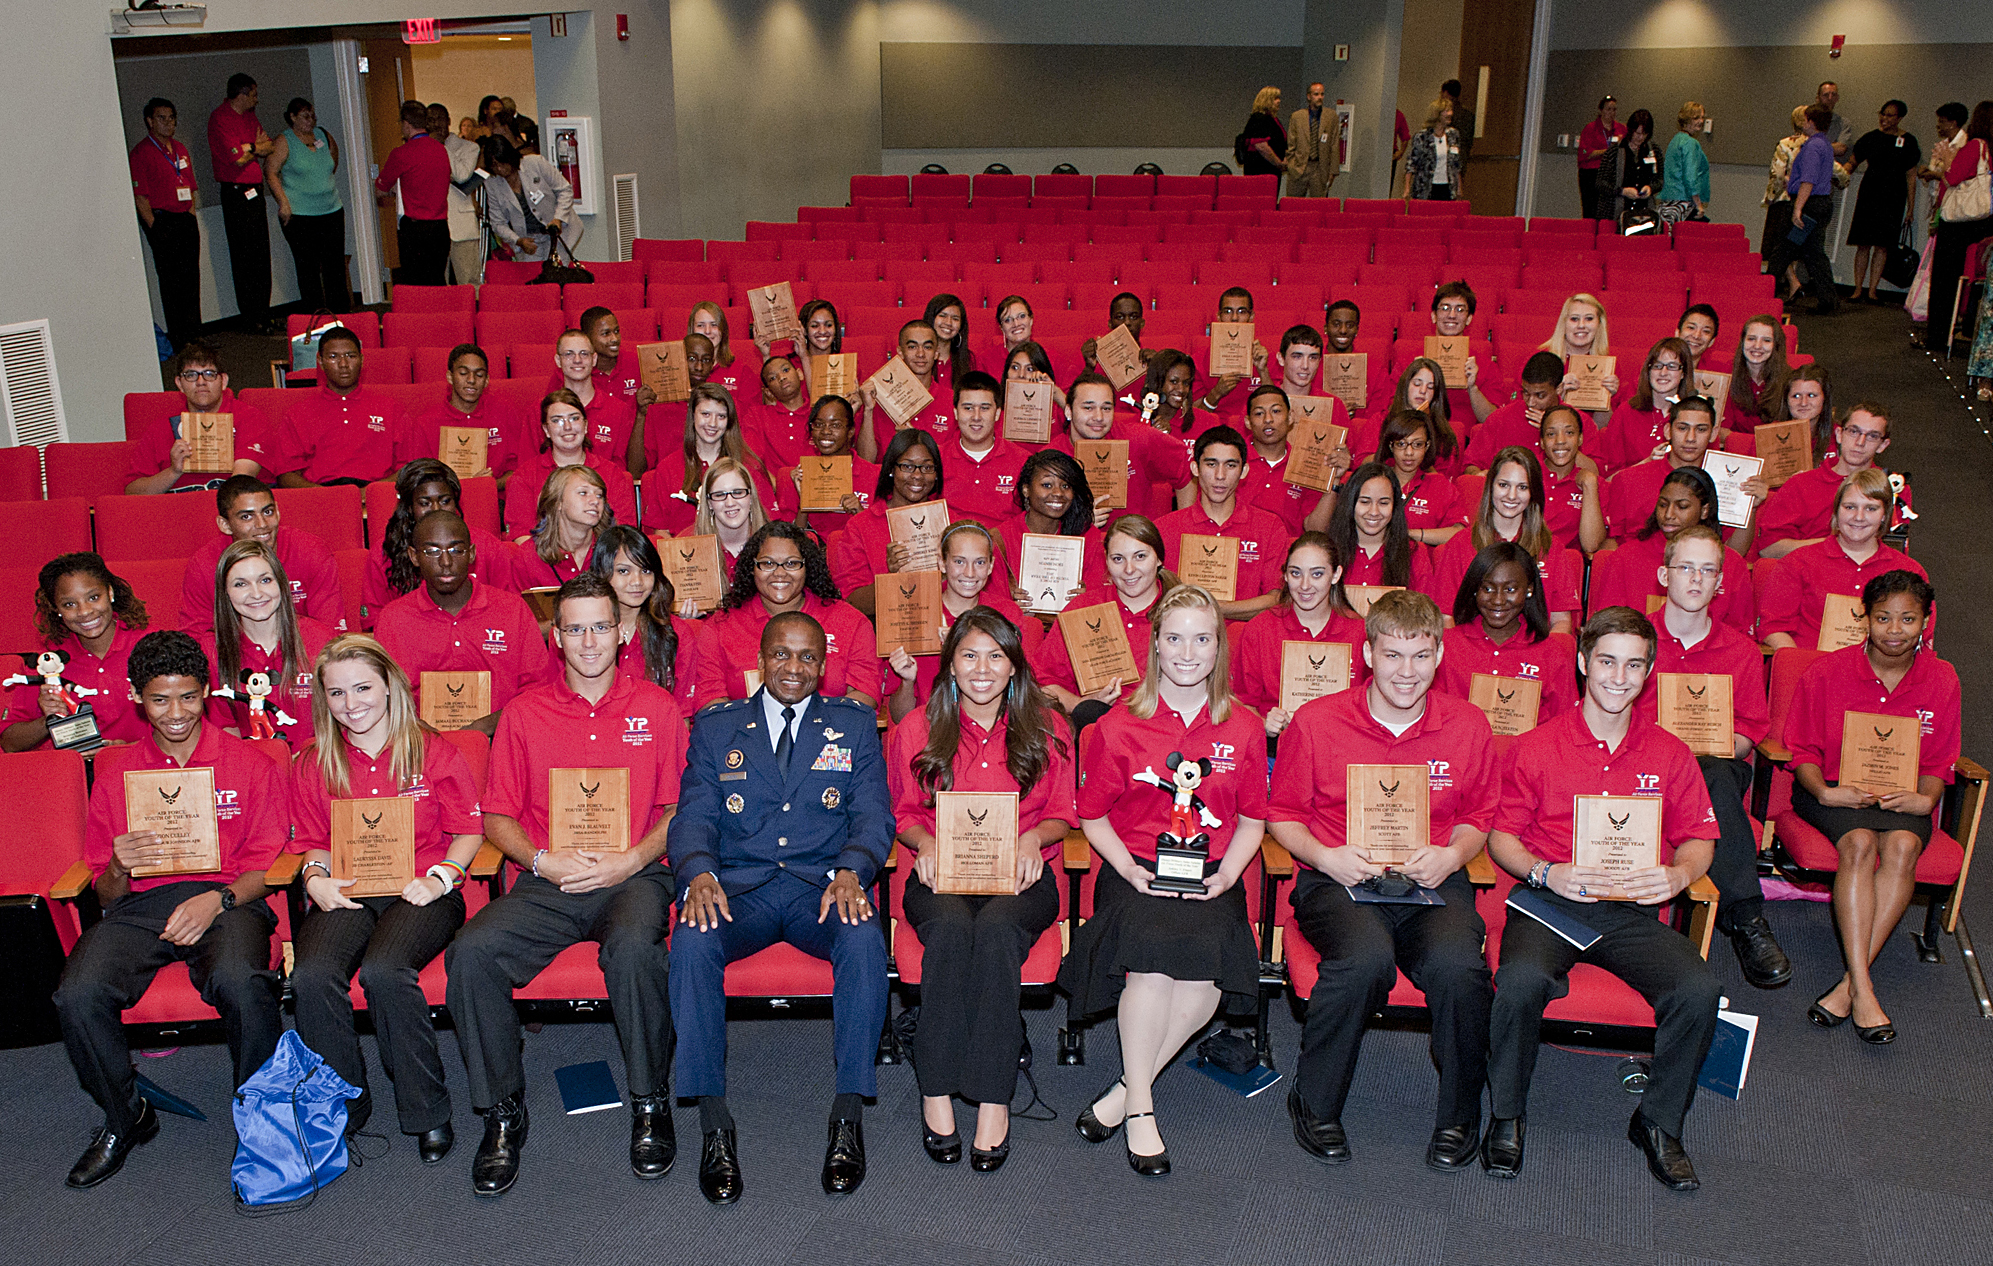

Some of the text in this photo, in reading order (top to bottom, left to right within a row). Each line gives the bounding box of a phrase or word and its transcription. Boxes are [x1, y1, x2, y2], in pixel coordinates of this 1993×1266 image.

[407, 18, 435, 41] EXIT
[369, 415, 383, 424] YP
[935, 414, 947, 423] YP
[598, 425, 611, 435] YP
[998, 475, 1013, 484] YP
[1412, 497, 1428, 507] YP
[1240, 540, 1258, 552] YP
[485, 629, 505, 641] YP
[1520, 662, 1540, 675] YP
[1915, 709, 1934, 723] YP
[625, 717, 648, 730] YP
[1211, 743, 1235, 758] YP
[1427, 759, 1450, 775] YP
[1636, 772, 1660, 787] YP
[216, 789, 237, 804] YP
